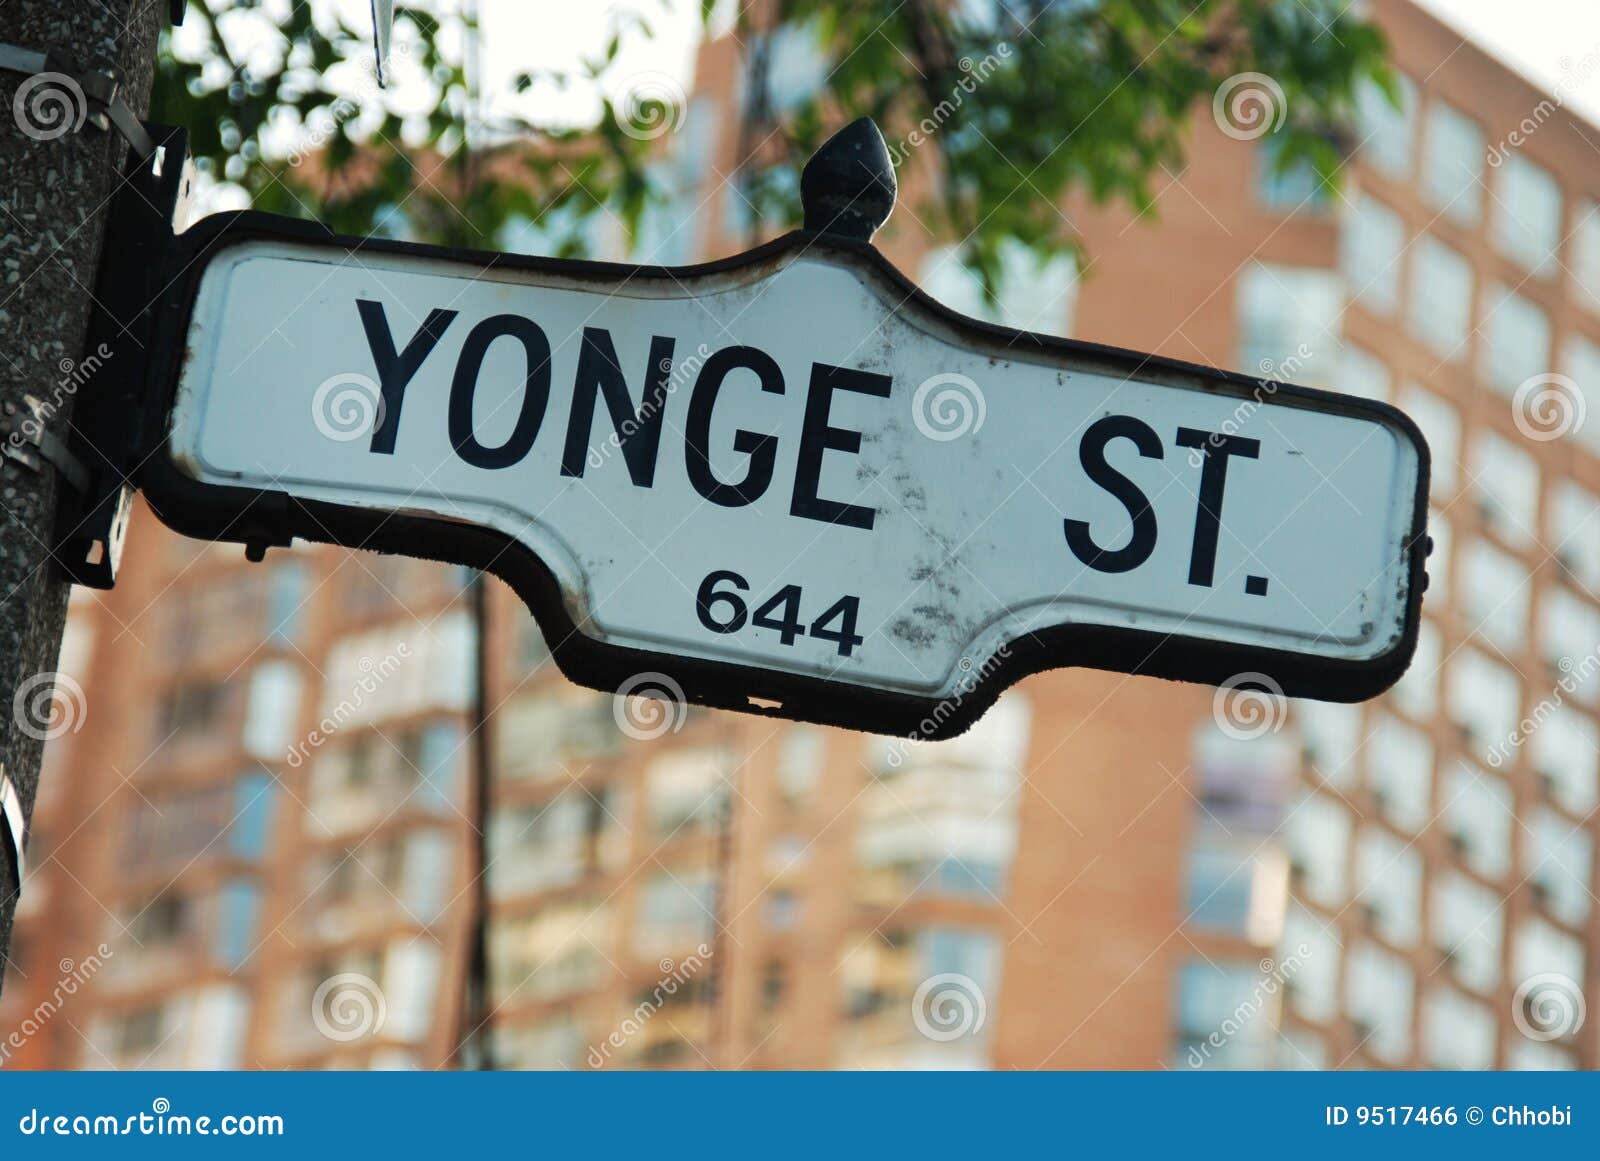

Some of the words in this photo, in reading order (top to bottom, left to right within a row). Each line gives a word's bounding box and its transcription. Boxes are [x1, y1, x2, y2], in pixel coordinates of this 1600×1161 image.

[356, 299, 893, 530] YONGE
[1064, 415, 1269, 597] ST.
[695, 570, 863, 657] 644
